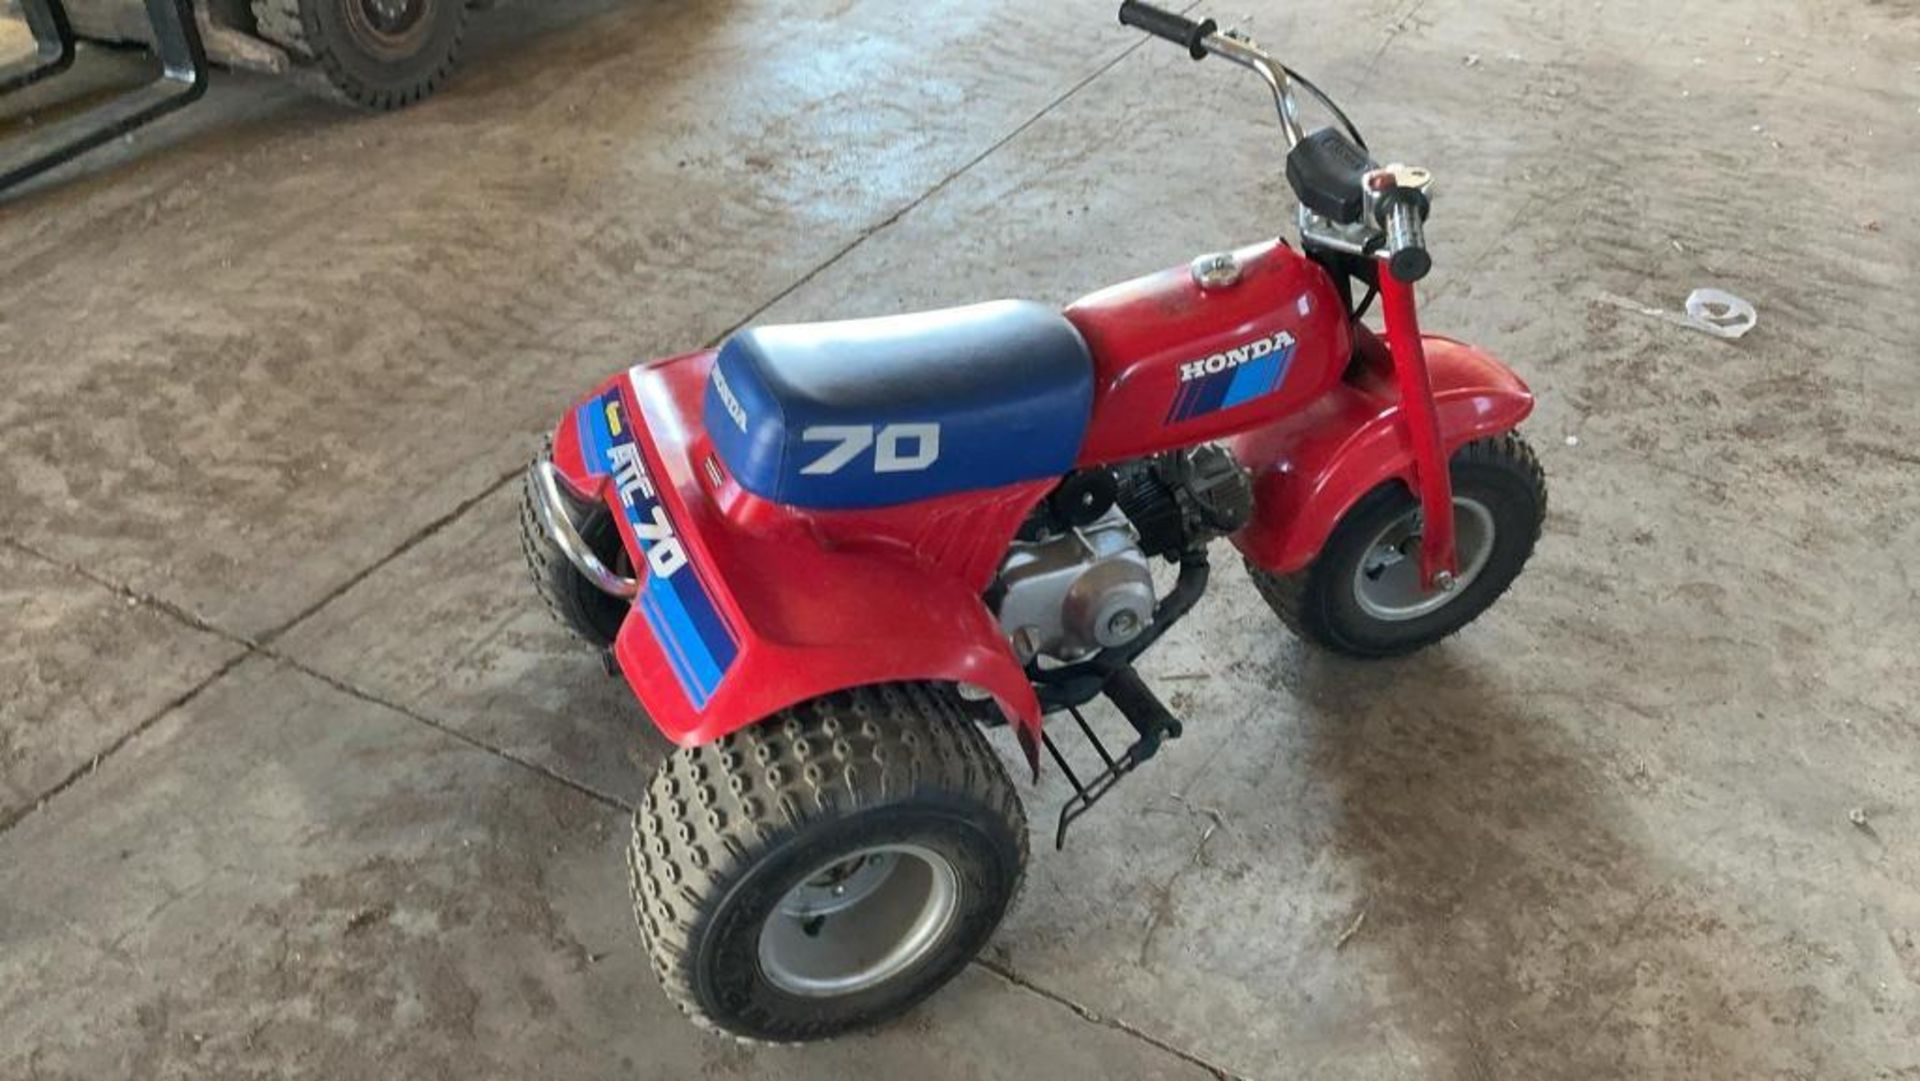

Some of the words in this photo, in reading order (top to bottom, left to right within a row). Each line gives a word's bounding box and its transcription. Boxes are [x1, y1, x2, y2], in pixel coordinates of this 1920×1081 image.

[1180, 330, 1295, 382] HONDA
[800, 423, 940, 475] 70
[606, 442, 655, 508] ATC
[633, 505, 688, 579] 70
